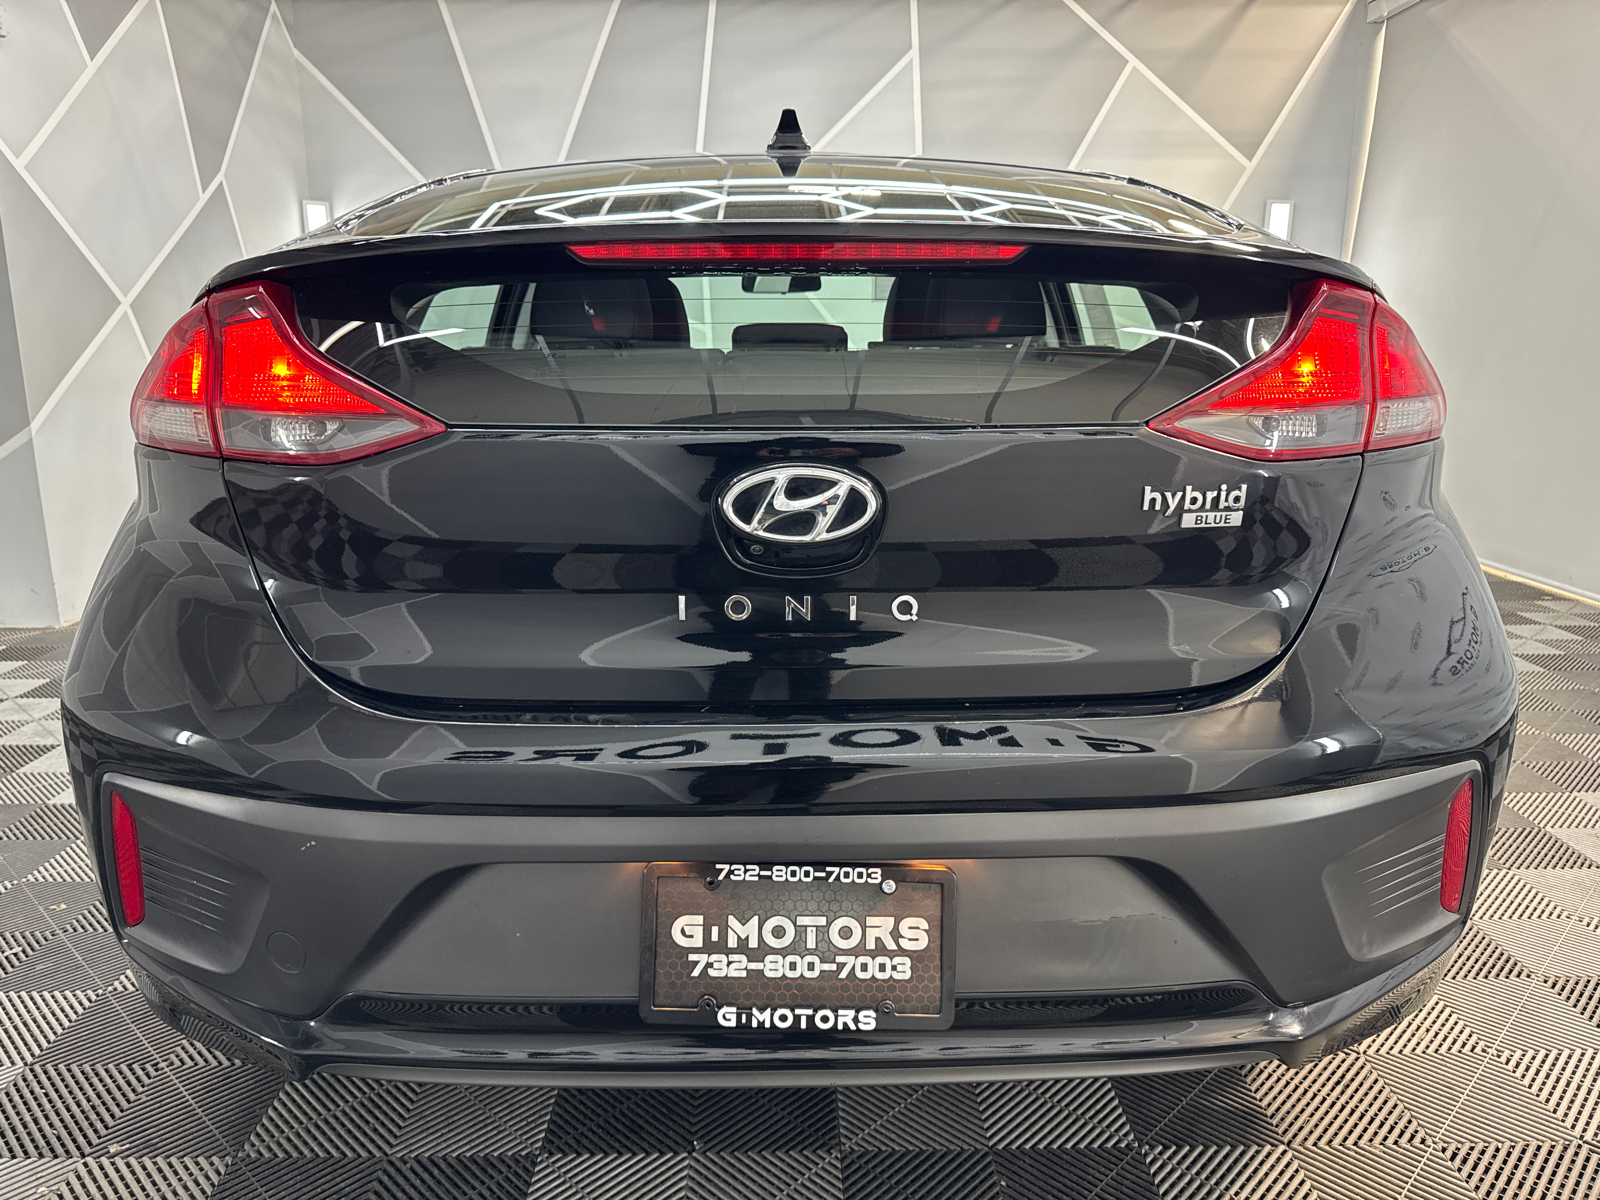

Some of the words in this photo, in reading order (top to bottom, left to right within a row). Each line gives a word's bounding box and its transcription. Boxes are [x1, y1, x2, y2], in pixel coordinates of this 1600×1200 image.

[1142, 484, 1248, 517] hybrid
[1194, 513, 1232, 526] BLUE
[678, 594, 919, 622] IONIQ
[715, 864, 882, 884] 732-800-7003
[687, 953, 912, 981] 732-800-7003
